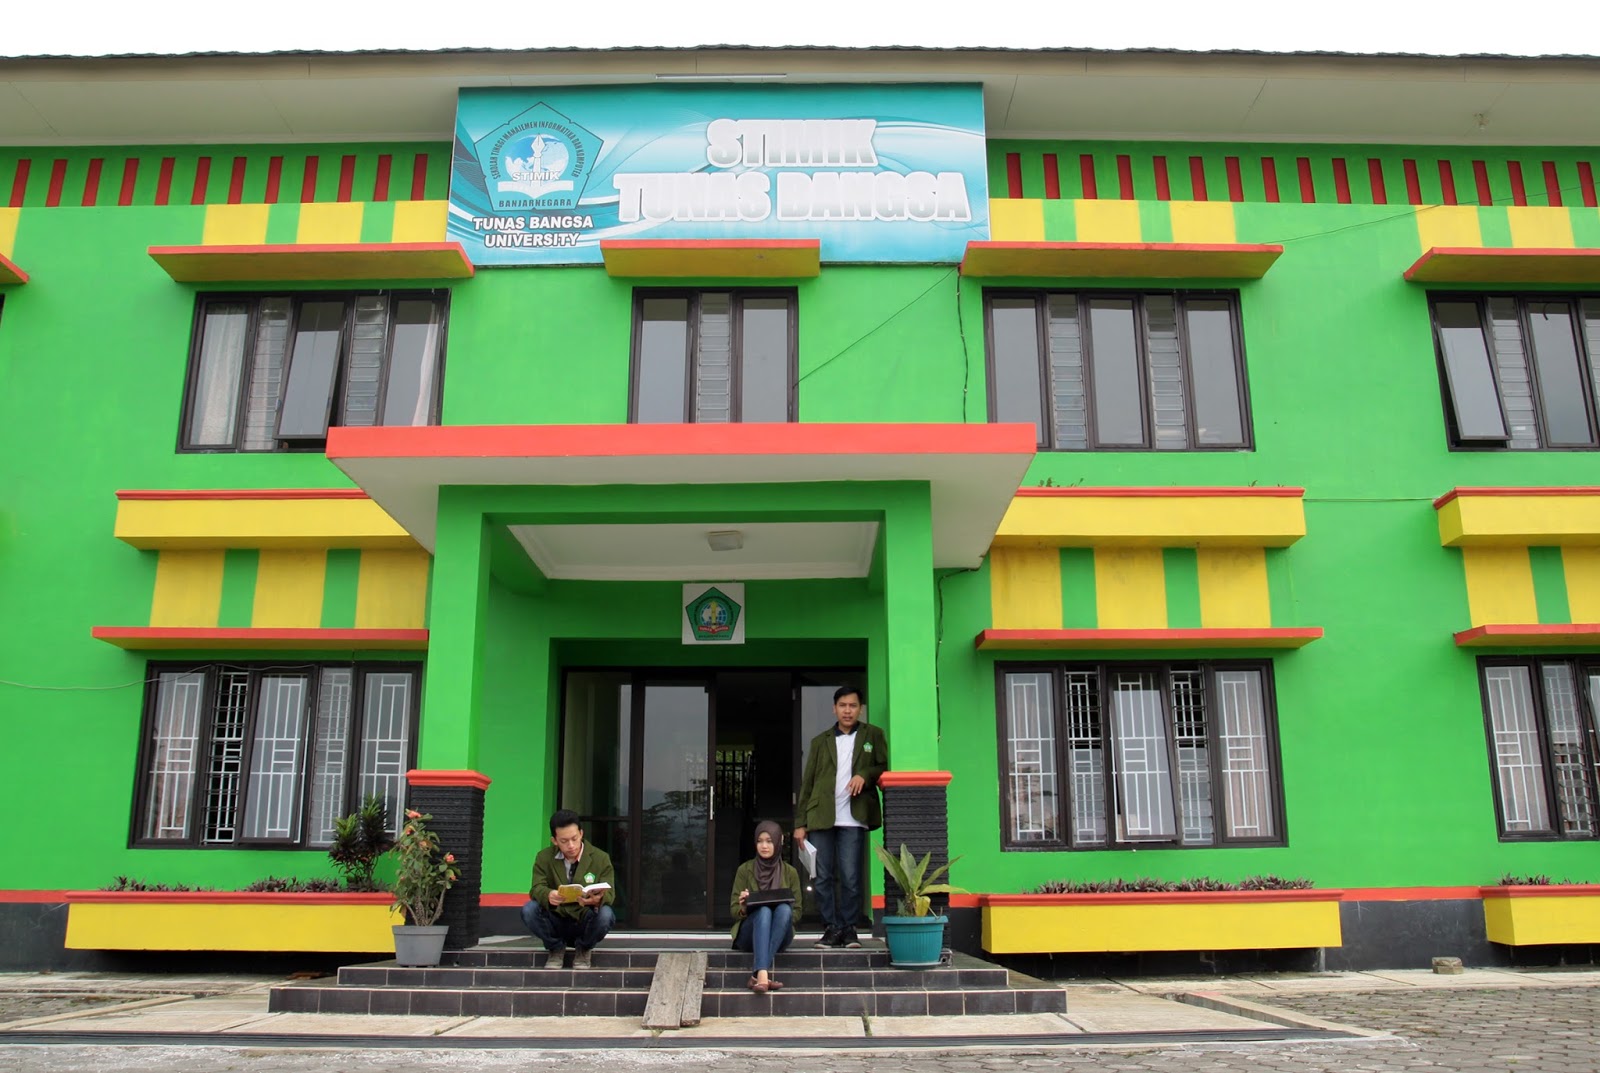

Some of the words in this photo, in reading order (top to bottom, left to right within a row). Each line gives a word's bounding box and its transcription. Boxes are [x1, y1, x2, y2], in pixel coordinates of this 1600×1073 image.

[503, 121, 538, 141] MANAJEMEN
[538, 121, 577, 141] INFORMATIKA
[571, 138, 583, 150] DAN
[706, 118, 879, 168] STIMIK
[490, 156, 501, 180] SEKOLAH
[571, 149, 585, 178] KOMPUTER
[512, 171, 560, 182] STIMIK
[498, 198, 572, 208] BANJARNEGARA
[613, 172, 772, 222] TUNAS
[776, 171, 972, 222] BANGSA
[472, 216, 526, 231] TUNAS
[529, 215, 594, 230] BANGSA
[484, 232, 581, 248] UNIVERSITY
